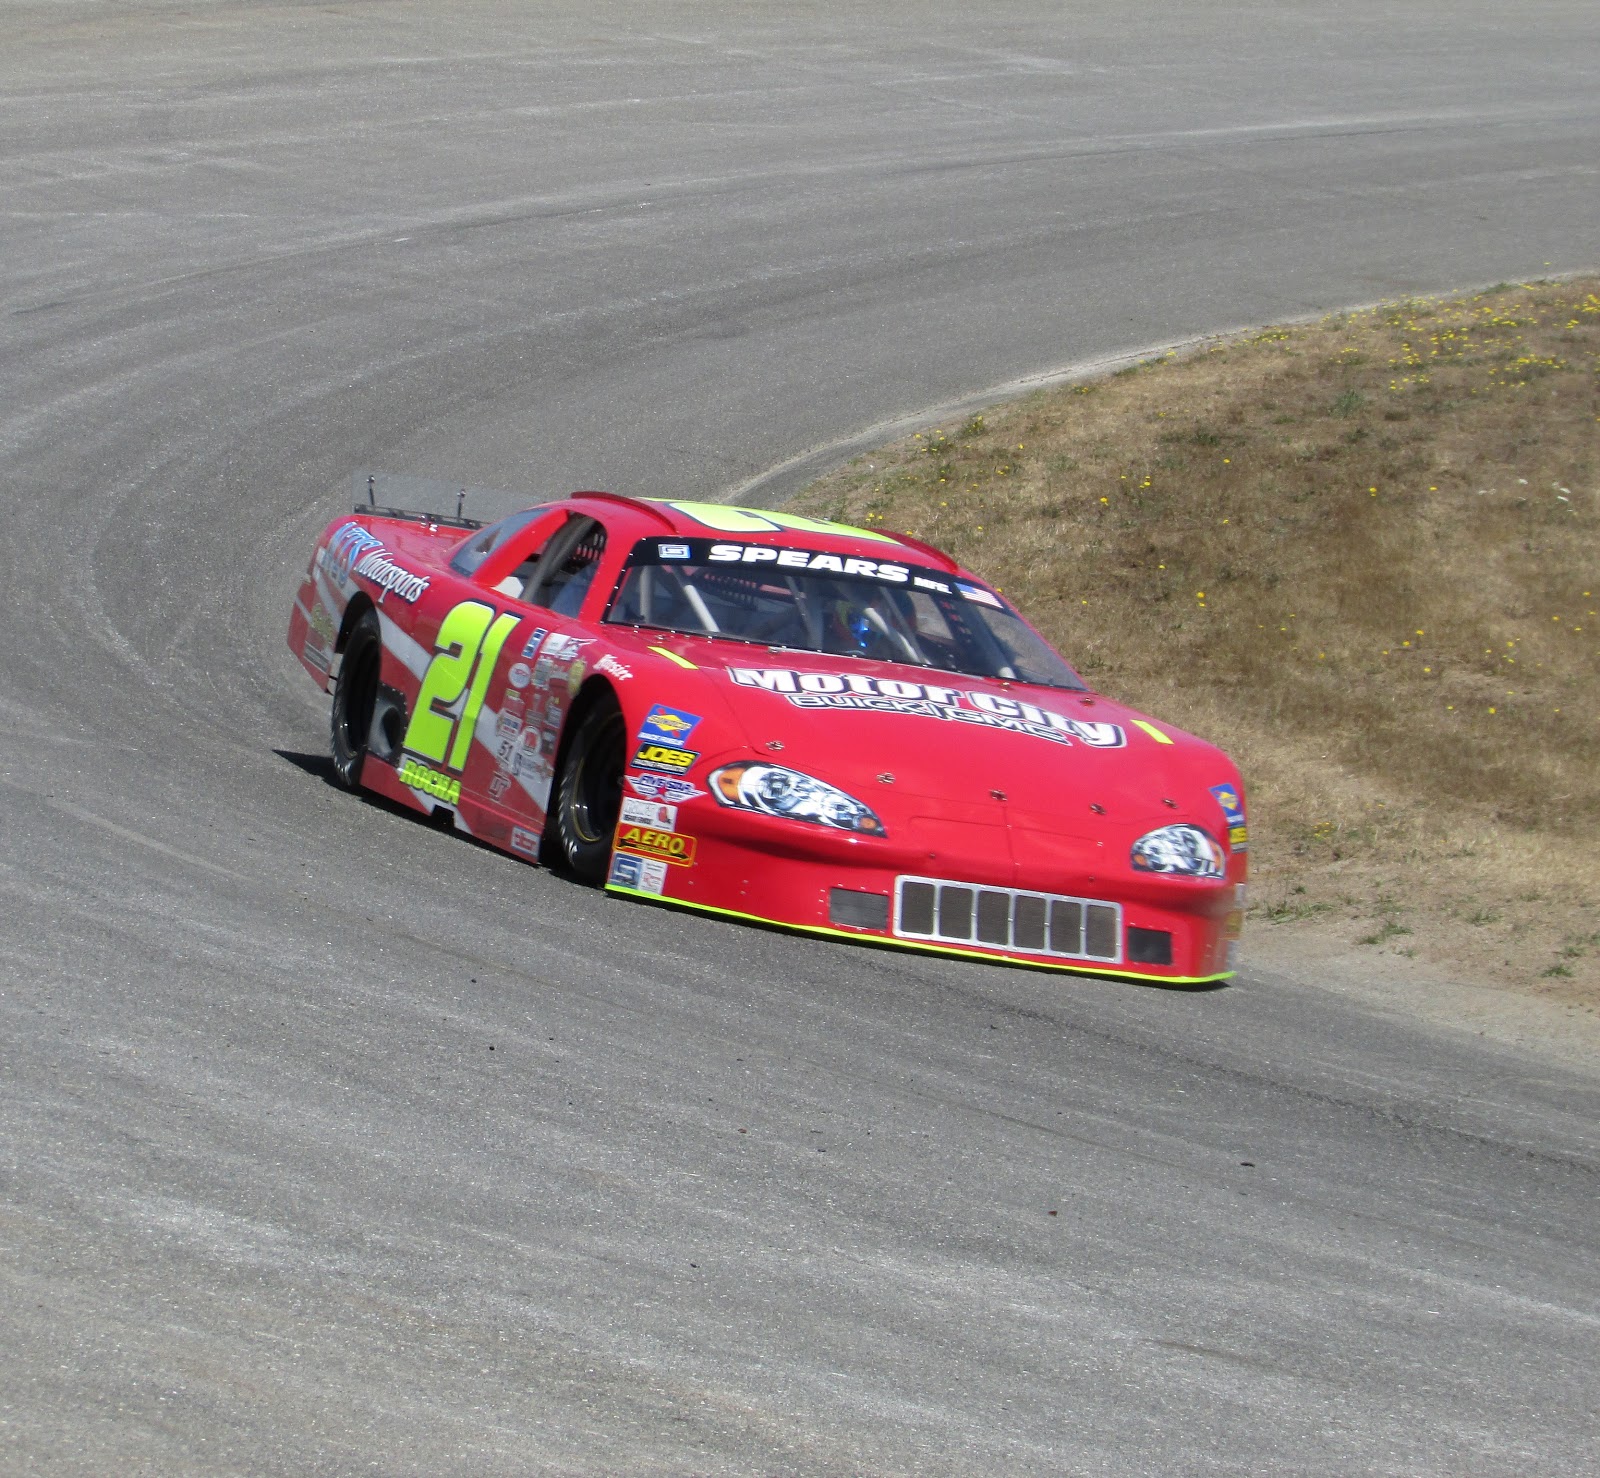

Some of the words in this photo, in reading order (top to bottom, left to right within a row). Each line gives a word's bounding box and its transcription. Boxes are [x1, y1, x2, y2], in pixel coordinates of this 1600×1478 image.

[353, 548, 431, 603] Motorsports
[708, 545, 910, 582] SPEARS
[402, 600, 522, 775] 21
[727, 666, 965, 707] Motor
[965, 691, 1127, 748] City
[637, 746, 695, 767] JOES
[399, 758, 462, 805] ROCHA
[624, 828, 685, 853] AERO
